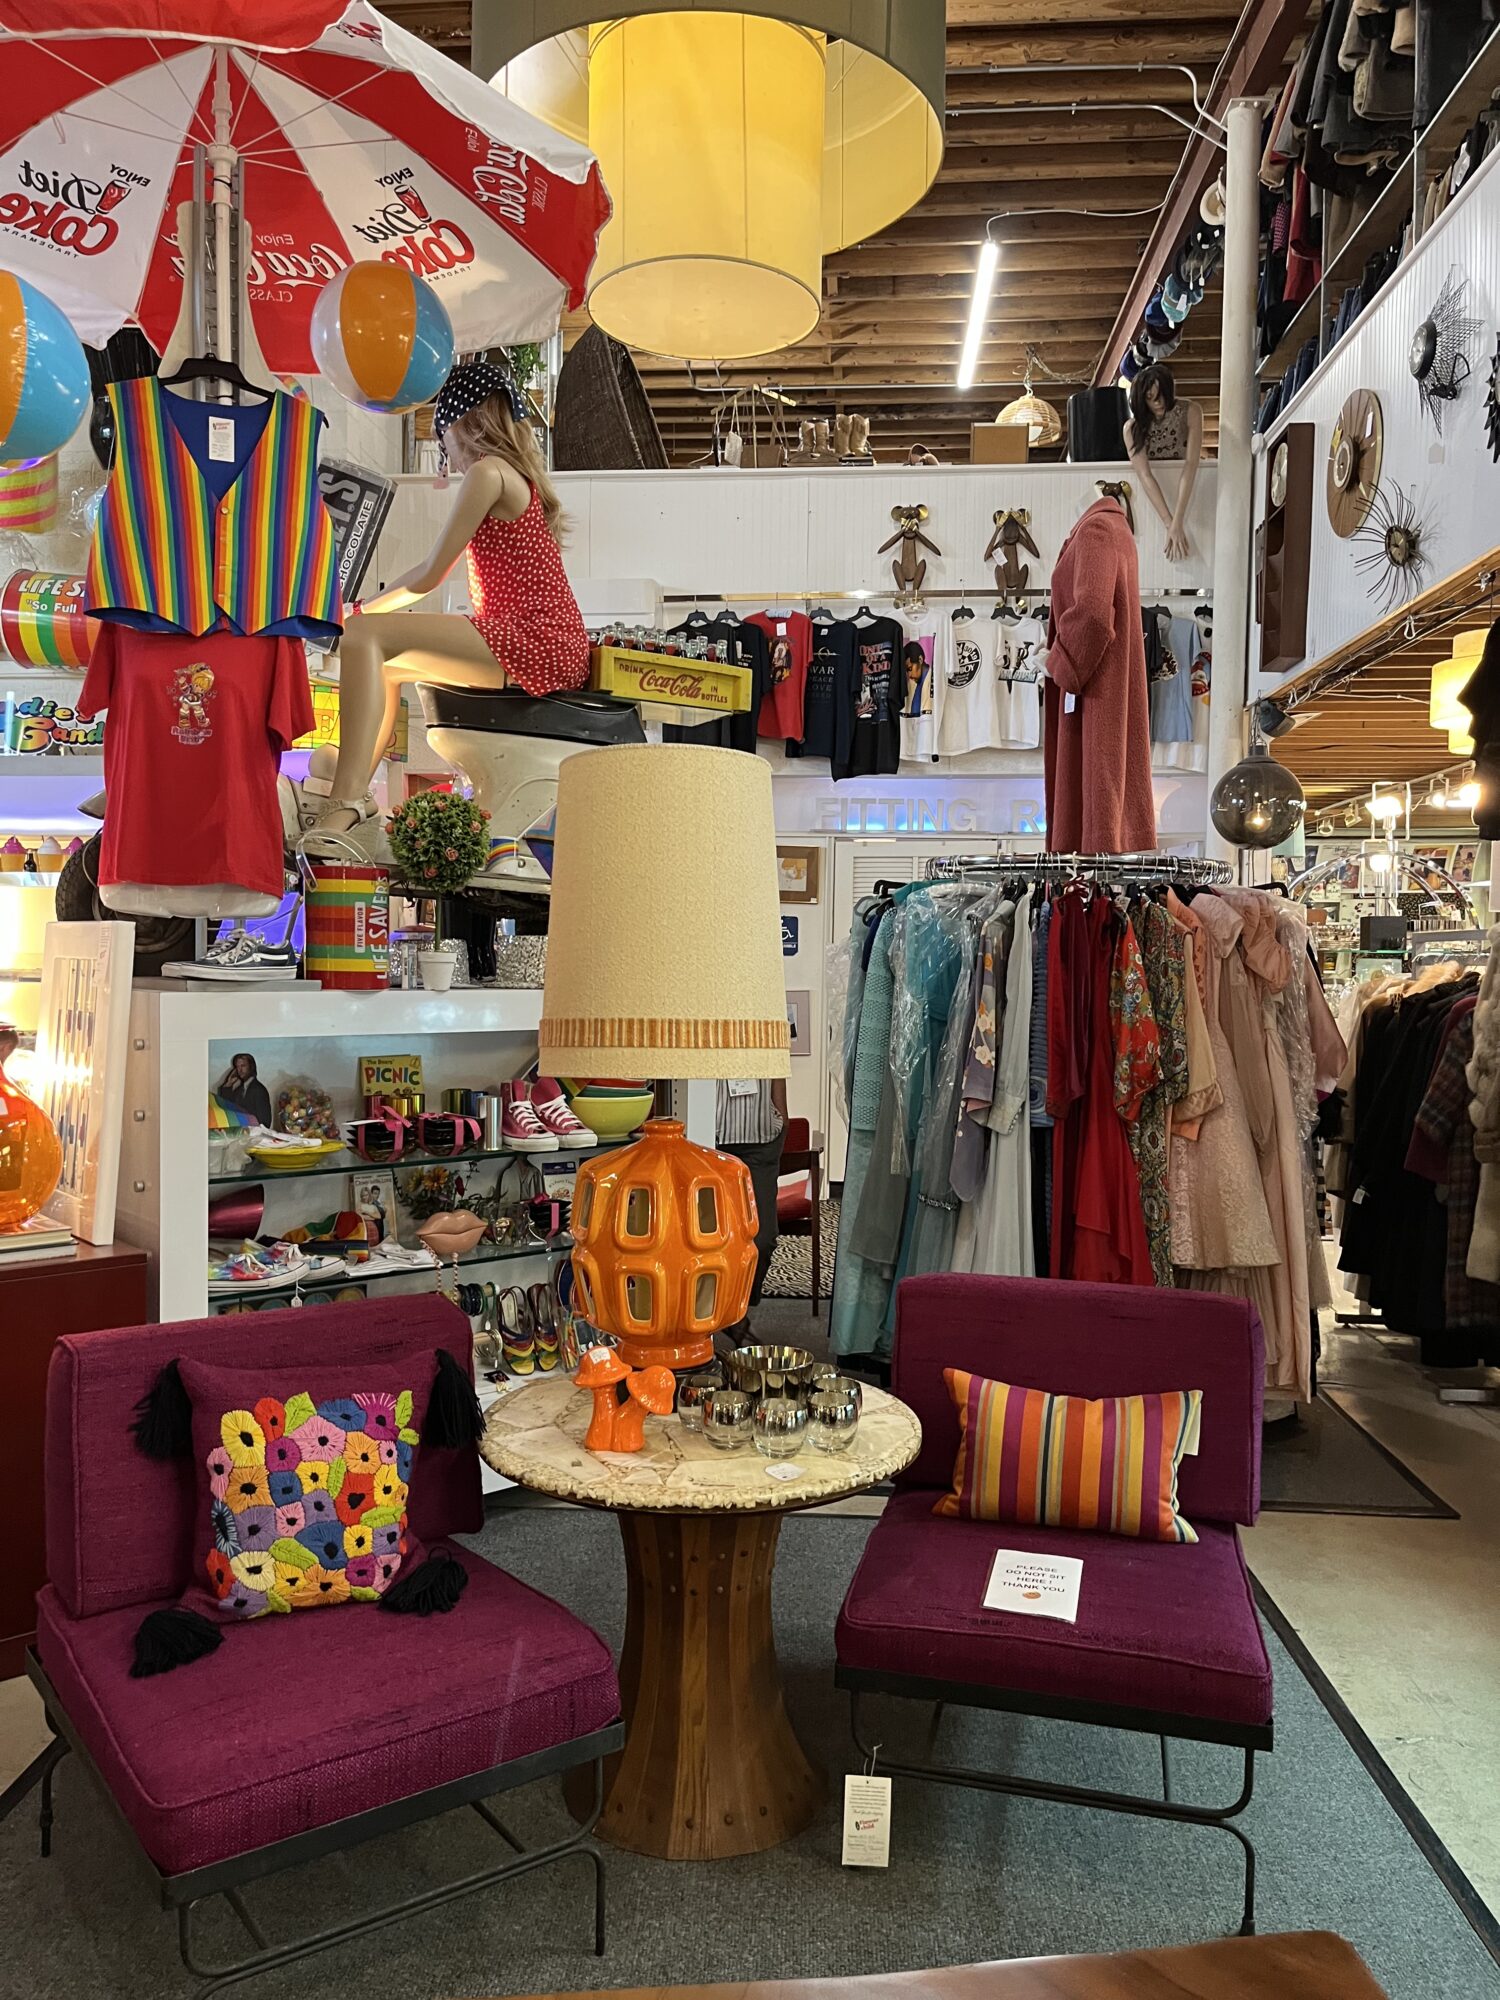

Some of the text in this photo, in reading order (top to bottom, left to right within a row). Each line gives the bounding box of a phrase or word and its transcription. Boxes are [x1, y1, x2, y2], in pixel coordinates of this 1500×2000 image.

[18, 579, 68, 596] LIFE
[54, 602, 78, 614] Full
[618, 663, 645, 675] DRINK
[862, 660, 892, 675] KIND
[639, 668, 704, 699] Coca-Cola
[710, 685, 719, 694] IN
[701, 692, 729, 704] BOTTLES
[815, 796, 978, 833] FITTING
[356, 906, 365, 949] FIVE FLAVOR
[368, 876, 389, 980] LIFE SAVERS
[364, 1066, 421, 1086] PICNIC
[1016, 1565, 1057, 1573] PLEASE
[1002, 1581, 1039, 1589] THANK
